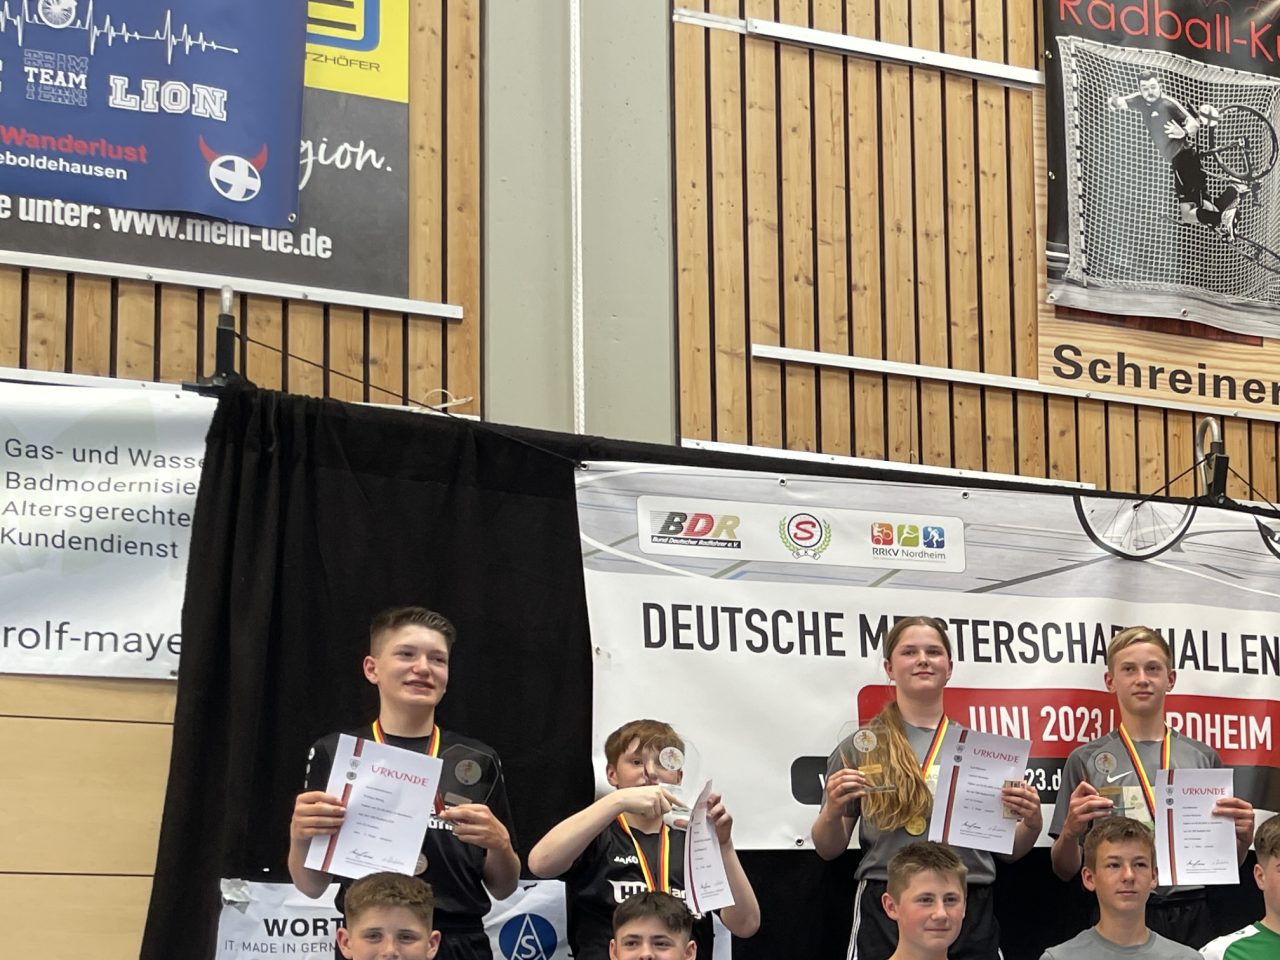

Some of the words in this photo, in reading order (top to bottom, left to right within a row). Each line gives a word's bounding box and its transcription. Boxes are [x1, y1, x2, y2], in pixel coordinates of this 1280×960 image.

[24, 66, 87, 90] TEAM
[109, 74, 228, 122] LION
[0, 125, 147, 164] Wanderlust
[18, 197, 102, 230] unter:
[5, 438, 63, 460] Gas-
[72, 446, 118, 465] und
[6, 471, 197, 495] Badmodernisie
[2, 500, 191, 528] Altersgerechte
[658, 511, 741, 539] BDR
[1, 527, 178, 559] Kundendienst
[873, 547, 900, 557] RRKV
[902, 548, 946, 560] Nordheim
[642, 602, 846, 657] DEUTSCHE
[859, 613, 1124, 667] MTERSCHA
[1040, 705, 1103, 743] 2023
[1165, 711, 1272, 751] RDHEIM
[973, 748, 1020, 764] URKUNDE
[371, 764, 430, 787] URKUNDE
[1182, 787, 1226, 796] URKUNDE
[242, 941, 278, 953] MADE
[282, 943, 296, 953] IN
